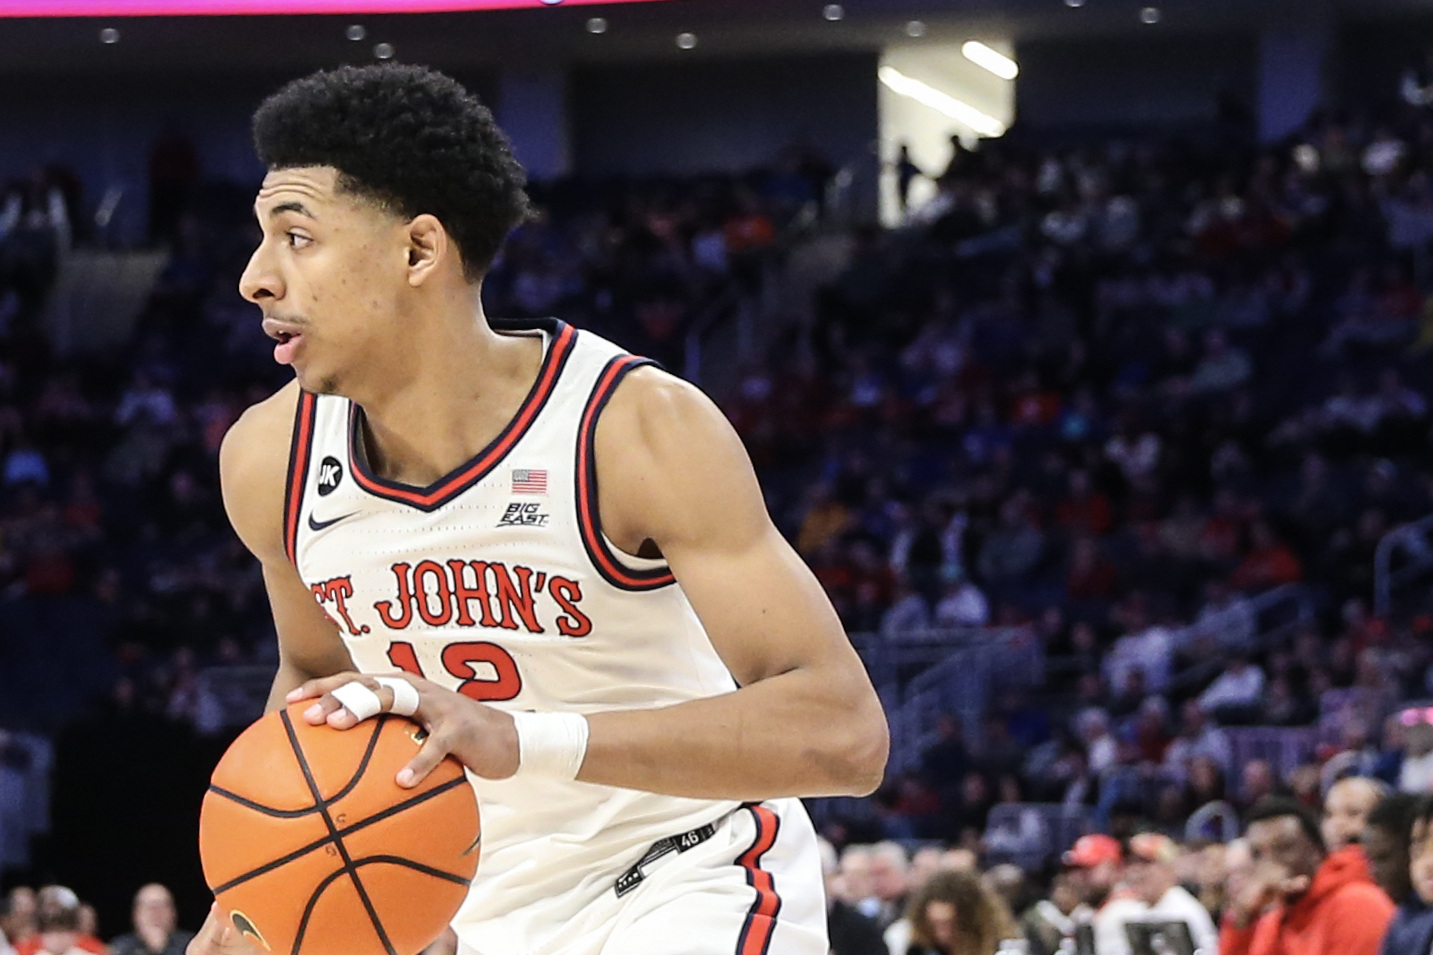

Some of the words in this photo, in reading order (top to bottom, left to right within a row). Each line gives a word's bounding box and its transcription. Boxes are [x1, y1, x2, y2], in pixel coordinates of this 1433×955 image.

[506, 503, 541, 513] BIG
[499, 513, 550, 525] EAST
[374, 559, 593, 637] JOHN'S
[680, 830, 700, 848] 46
